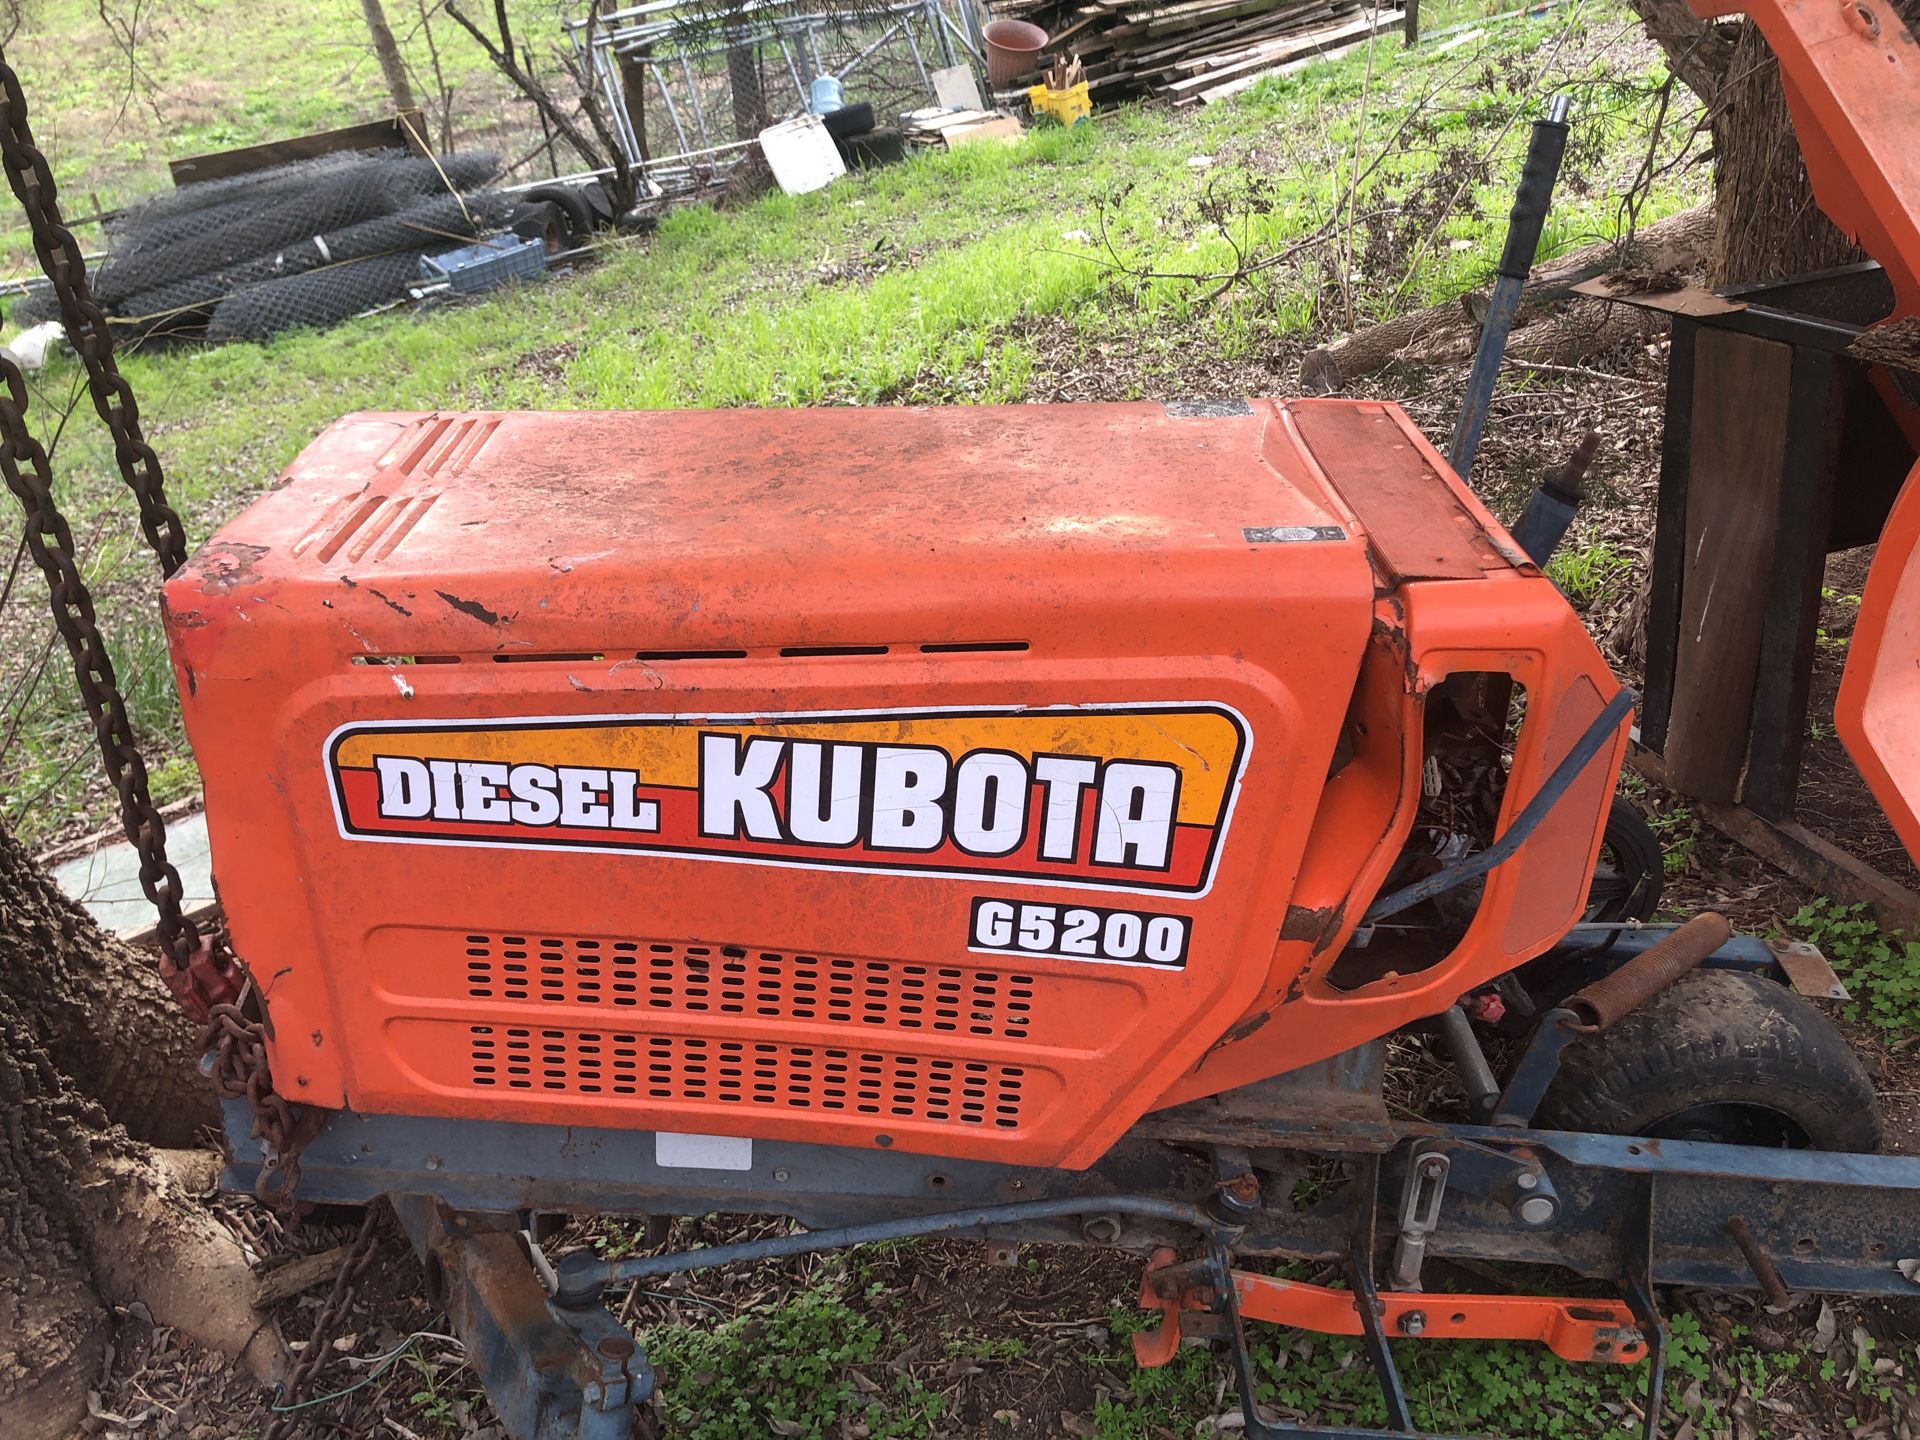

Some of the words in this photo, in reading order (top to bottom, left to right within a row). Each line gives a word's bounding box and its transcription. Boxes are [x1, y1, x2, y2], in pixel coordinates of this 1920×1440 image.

[375, 757, 658, 831] DIESEL
[703, 735, 1178, 869] KUBOTA
[975, 901, 1185, 962] G5200
